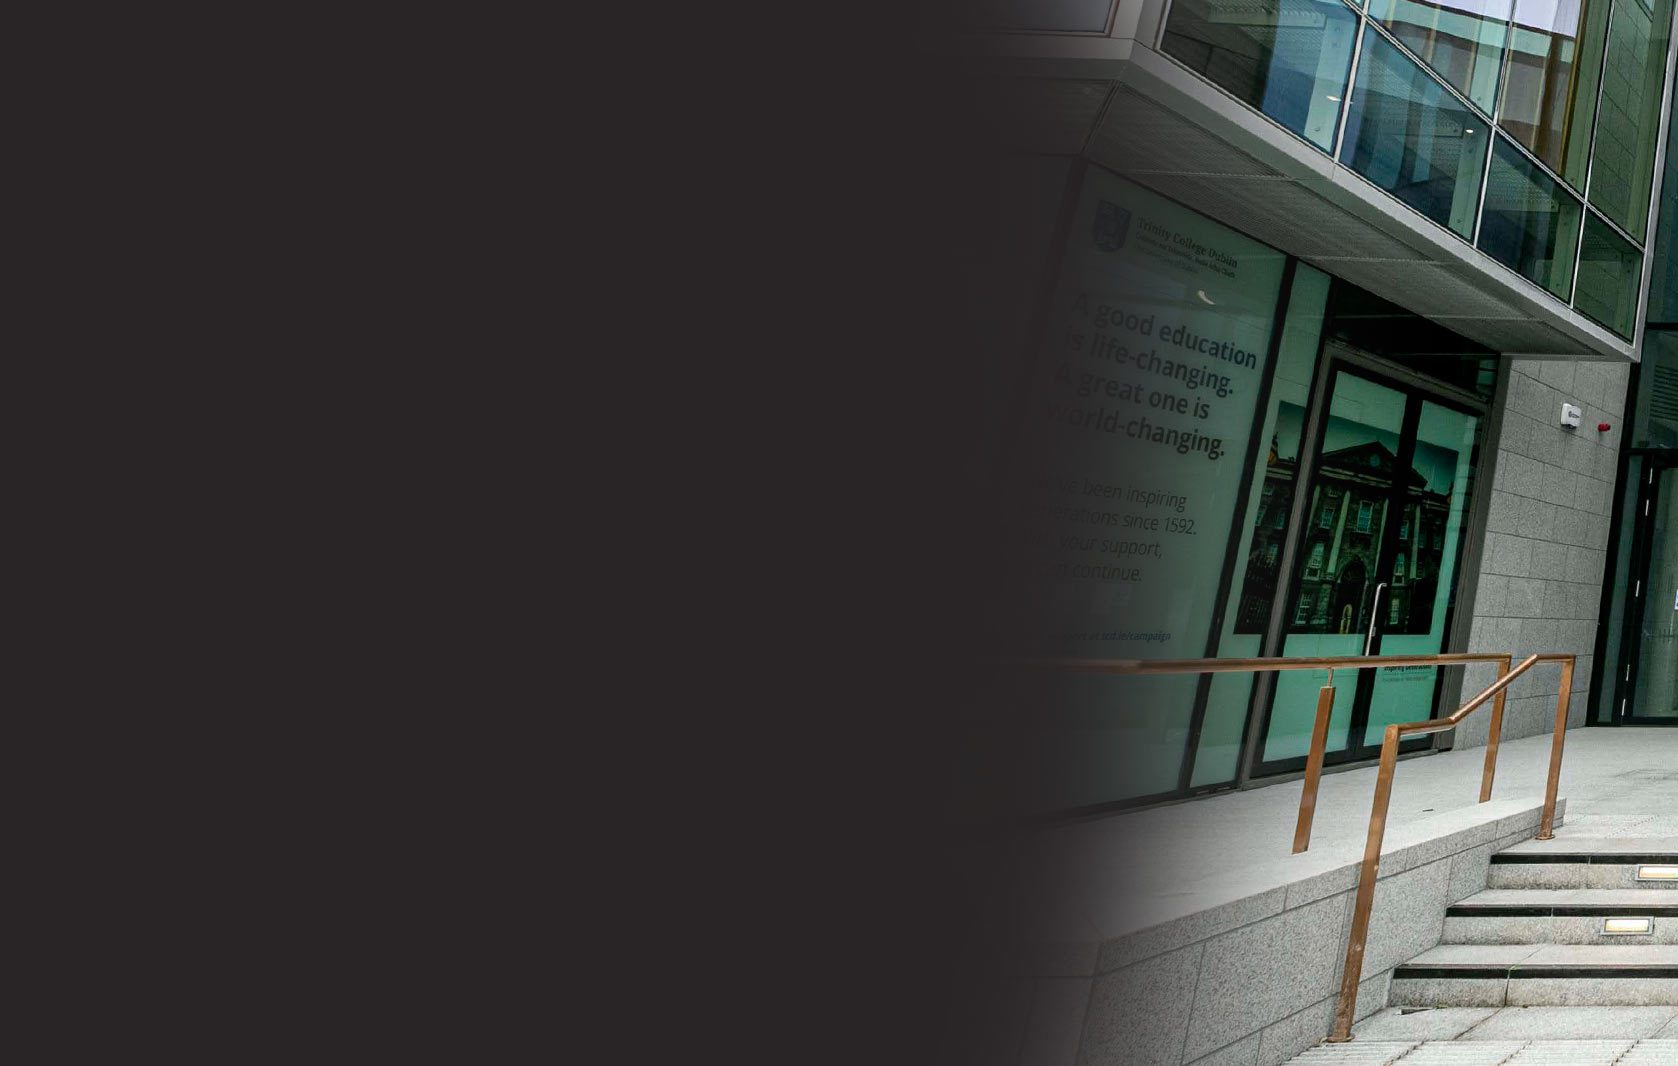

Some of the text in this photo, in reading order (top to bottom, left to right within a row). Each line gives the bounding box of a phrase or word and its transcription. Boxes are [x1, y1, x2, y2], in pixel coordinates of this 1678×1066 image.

[1137, 216, 1171, 240] Trinity
[1173, 233, 1206, 256] College
[1209, 248, 1238, 269] Dublin
[1094, 304, 1155, 336] good
[1158, 325, 1257, 369] education
[1089, 333, 1233, 398] life-changing.
[1076, 373, 1144, 404] great
[1149, 390, 1188, 414] one
[1193, 396, 1210, 419] is
[1048, 400, 1224, 460] world-changing.
[1127, 485, 1187, 512] inspiring
[1120, 511, 1159, 532] since
[1165, 517, 1198, 535] 1592.
[1072, 561, 1142, 582] continue.
[1101, 538, 1163, 560] support,
